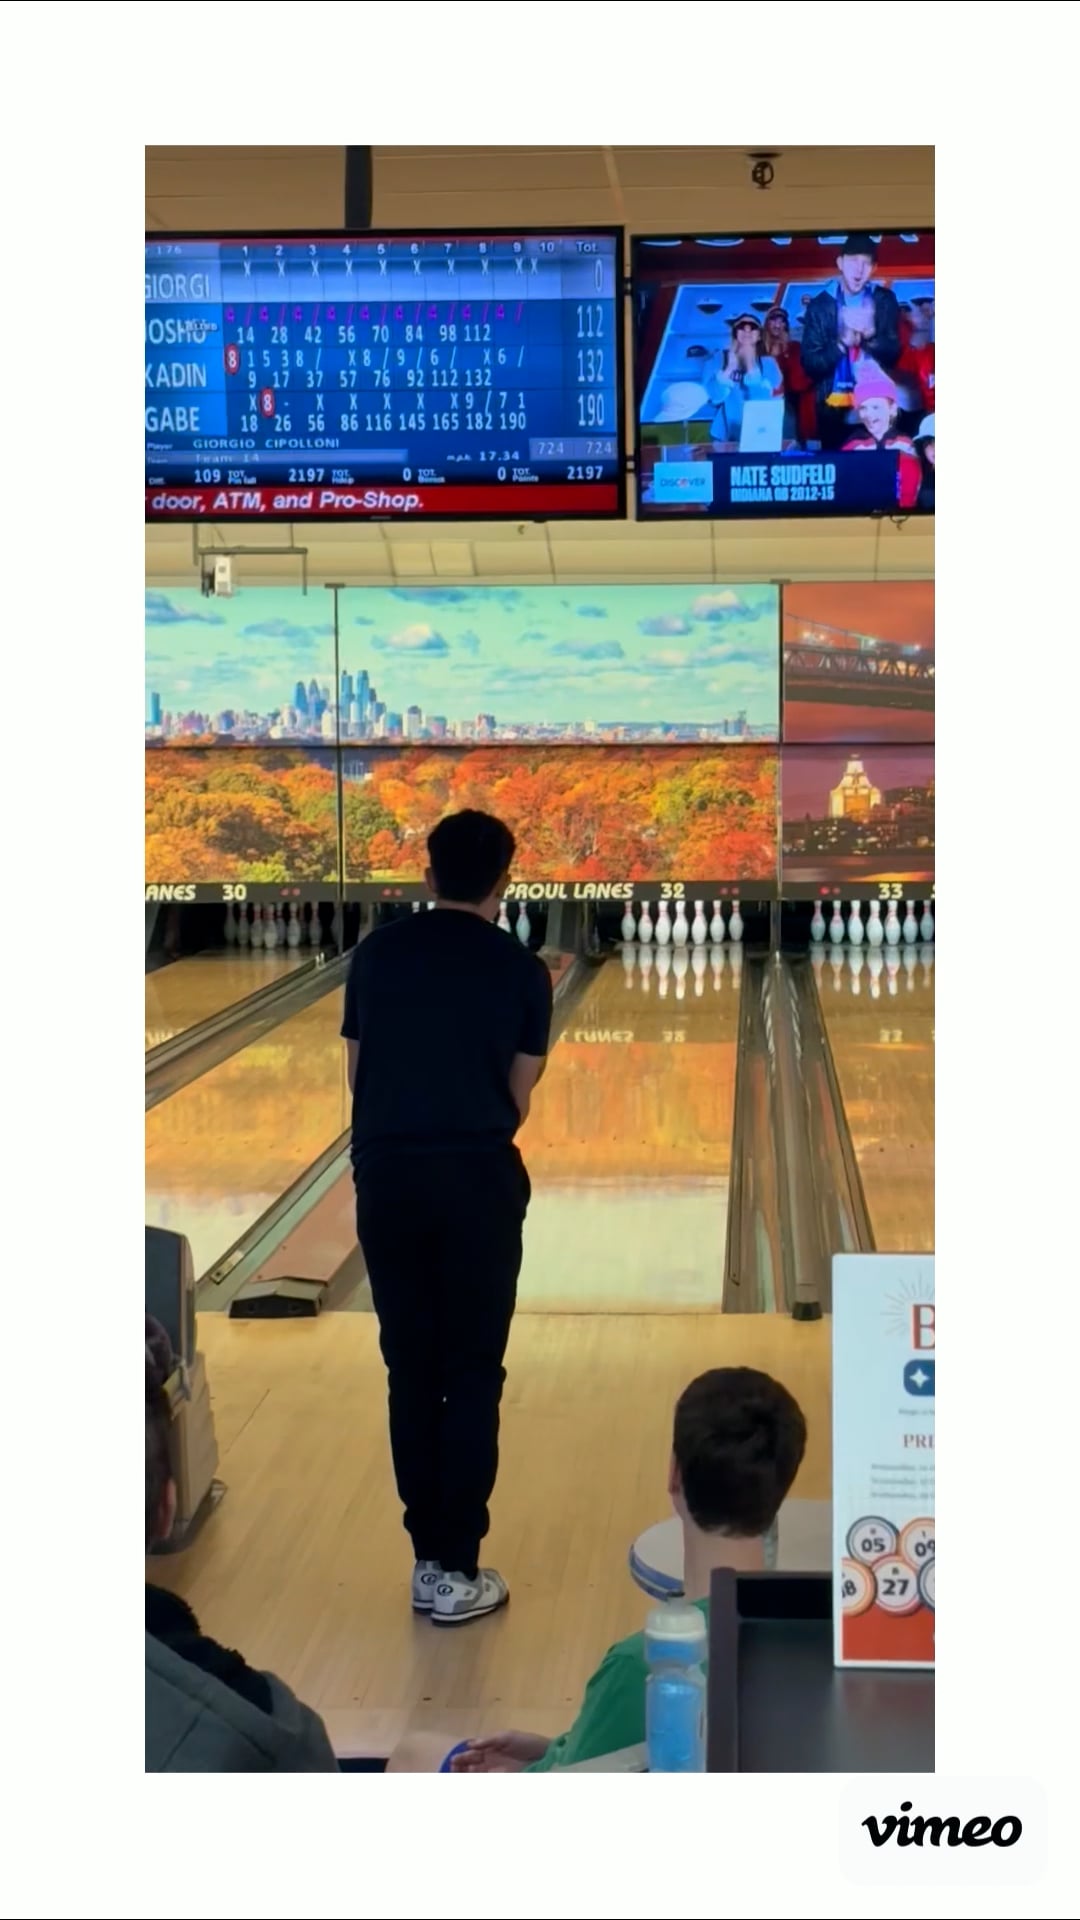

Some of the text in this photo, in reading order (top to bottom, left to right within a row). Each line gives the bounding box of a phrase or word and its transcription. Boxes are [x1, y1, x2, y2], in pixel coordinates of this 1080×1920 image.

[242, 246, 248, 256] 1
[275, 245, 283, 255] 2
[309, 245, 316, 255] 3
[342, 245, 350, 255] 4
[377, 244, 385, 254] 5
[411, 243, 418, 254] 6
[444, 243, 452, 253] 7
[479, 243, 486, 253] 8
[513, 243, 521, 252] 9
[539, 242, 554, 252] 10
[244, 258, 538, 277] X X X X X X X X X X
[595, 259, 602, 292] 0
[237, 305, 604, 344] 14 28 42 56 70 84 98 112 112
[228, 350, 237, 368] 8
[247, 350, 255, 368] 1
[263, 351, 270, 367] 5
[281, 351, 289, 367] 3
[296, 351, 303, 367] 8
[348, 350, 356, 367] X
[363, 349, 371, 366] 8
[397, 349, 404, 366] 9
[430, 349, 438, 365] 6
[484, 348, 491, 365] X
[498, 348, 506, 365] 6
[248, 349, 604, 388] 9 17 37 57 76 92 112 132 132
[249, 394, 257, 411] X
[264, 394, 272, 411] 8
[316, 394, 324, 410] X
[350, 393, 357, 410] X
[384, 393, 391, 410] X
[417, 393, 424, 409] X
[451, 392, 458, 409] X
[465, 392, 474, 409] 9
[500, 392, 507, 409] 7
[519, 392, 525, 409] 1
[145, 407, 199, 432] GABE
[241, 394, 604, 432] 18 26 56 86 116 145 165 182 190 190
[193, 439, 255, 449] GIORGIO
[265, 439, 339, 449] CIPOLLONI
[538, 441, 612, 455] 724 724
[480, 451, 520, 461] 17.34
[195, 469, 221, 483] 109
[289, 468, 324, 482] 2197
[403, 468, 411, 481] 0
[497, 466, 506, 481] 0
[567, 466, 603, 480] 2197
[731, 464, 836, 486] NATE SUDFELD
[152, 491, 424, 513] door, ATM, and Pro-Shop.
[731, 487, 772, 502] INDIANA
[791, 486, 835, 501] 2012-15
[222, 884, 247, 900] 30
[574, 883, 634, 899] LANES
[661, 883, 685, 899] 32
[878, 883, 903, 900] 33
[861, 1538, 886, 1553] 05
[882, 1578, 909, 1596] 27
